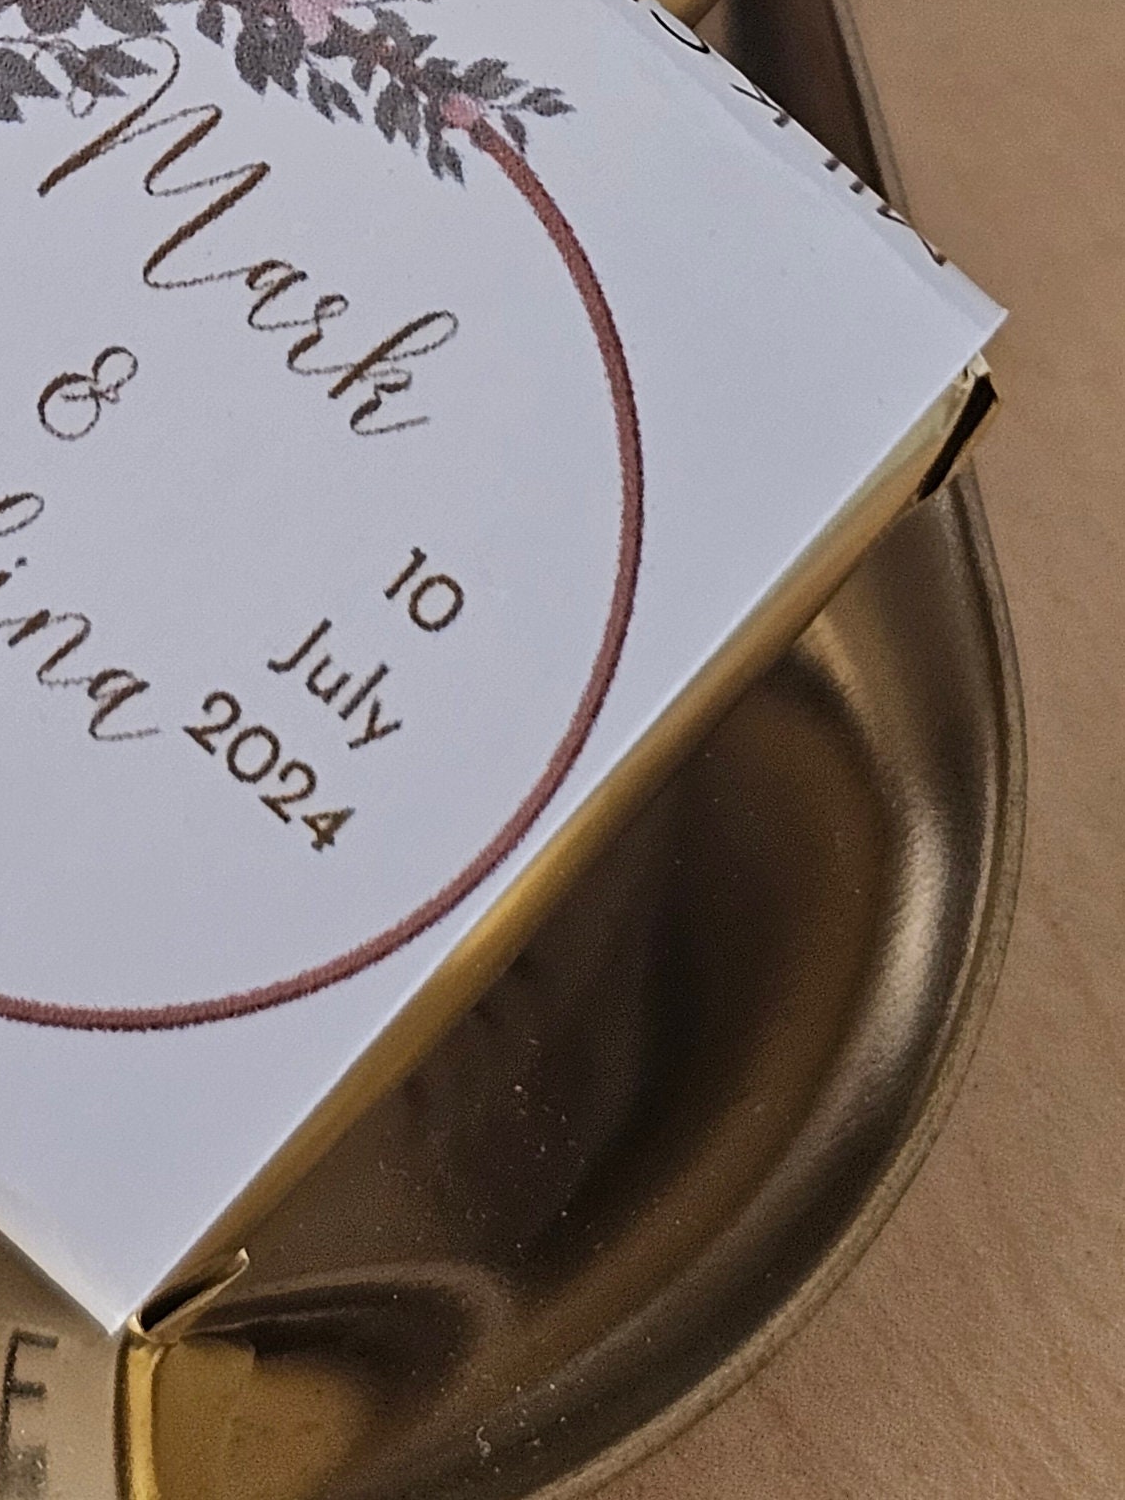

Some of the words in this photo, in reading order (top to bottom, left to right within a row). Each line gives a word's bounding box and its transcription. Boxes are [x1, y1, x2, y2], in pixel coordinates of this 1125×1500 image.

[37, 34, 460, 436] Mark
[730, 81, 948, 267] MILK
[38, 345, 139, 441] &
[383, 546, 466, 633] 10
[266, 618, 404, 750] July
[182, 690, 357, 853] 2024
